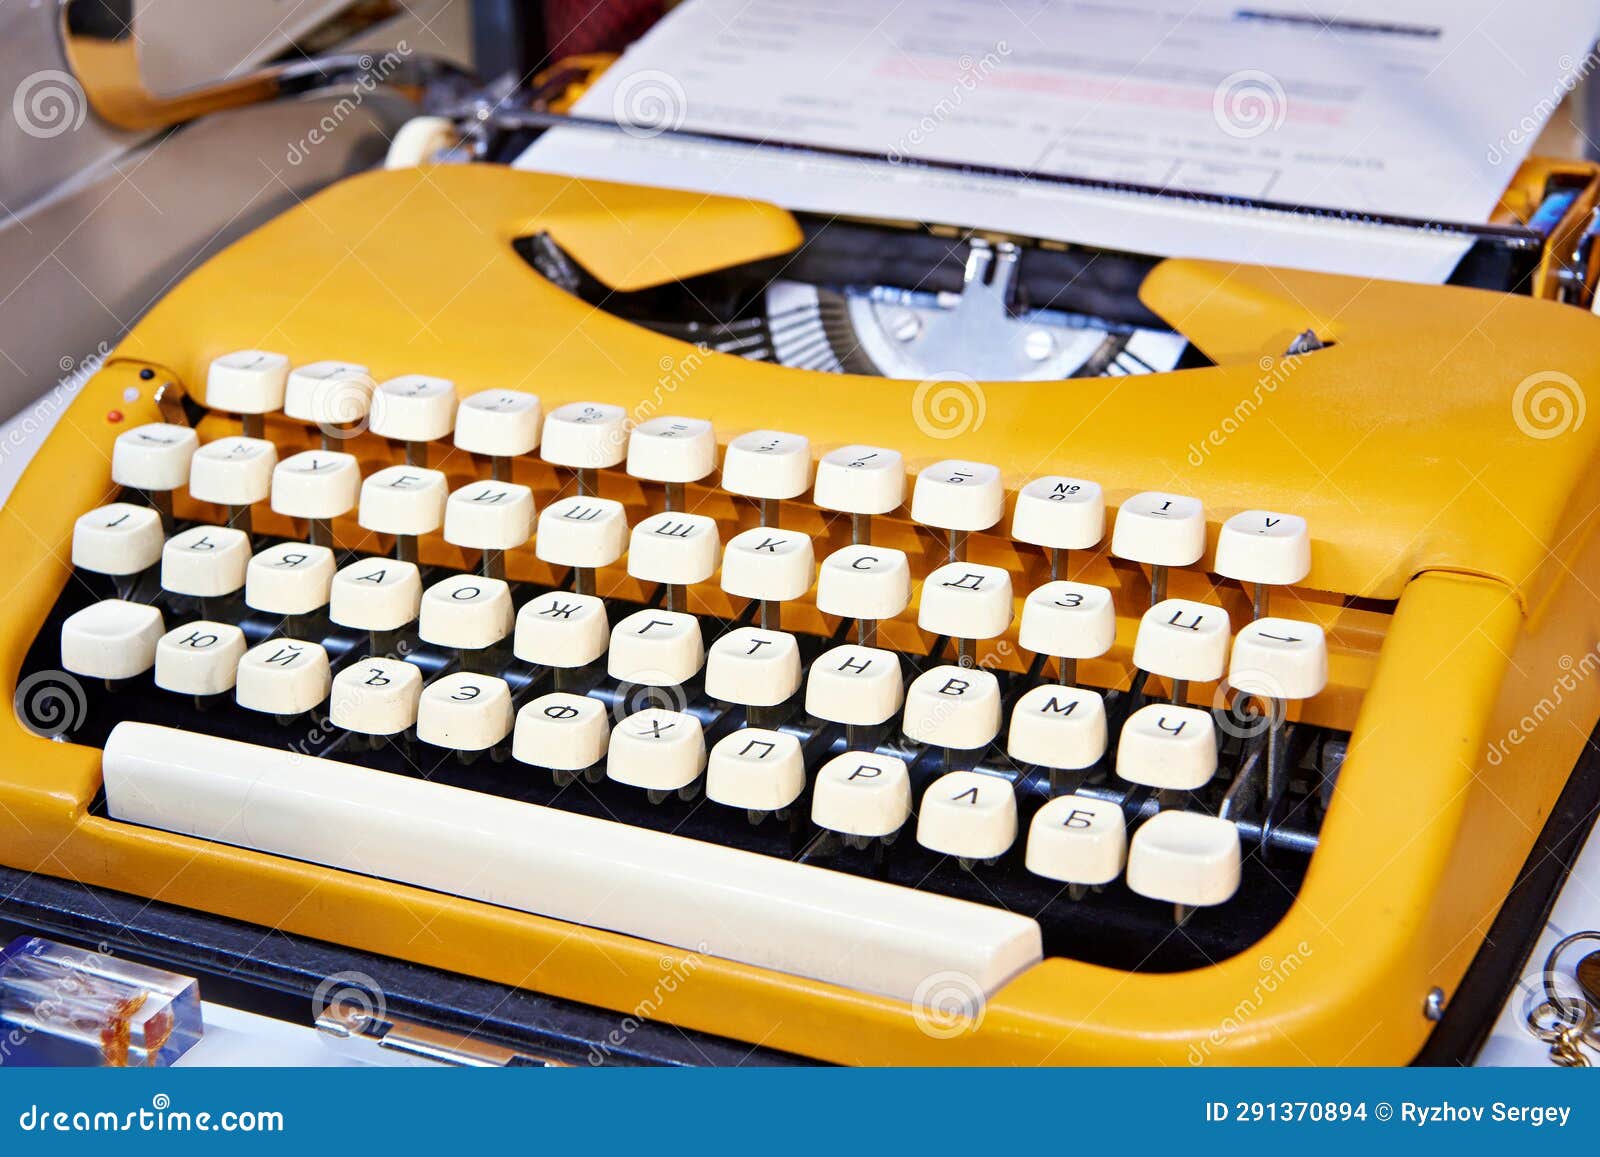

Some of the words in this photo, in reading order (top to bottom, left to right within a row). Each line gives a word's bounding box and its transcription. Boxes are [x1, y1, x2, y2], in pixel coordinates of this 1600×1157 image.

[390, 476, 418, 487] Е
[472, 490, 506, 503] И
[755, 538, 787, 552] К
[282, 554, 308, 567] Я
[356, 570, 386, 583] А
[942, 574, 984, 590] Д
[540, 600, 582, 619] Ж
[638, 620, 673, 634] Г
[1168, 610, 1203, 631] Ц
[180, 631, 218, 648] Ю
[747, 639, 772, 655] Т
[265, 645, 303, 666] Й
[838, 657, 872, 674] Н
[451, 686, 480, 700] Э
[938, 678, 969, 695] В
[544, 706, 579, 719] Ф
[1040, 697, 1079, 716] М
[638, 720, 675, 738] Х
[1158, 717, 1186, 736] Ч
[739, 740, 775, 759] П
[848, 765, 882, 780] Р
[1063, 810, 1095, 828] Б
